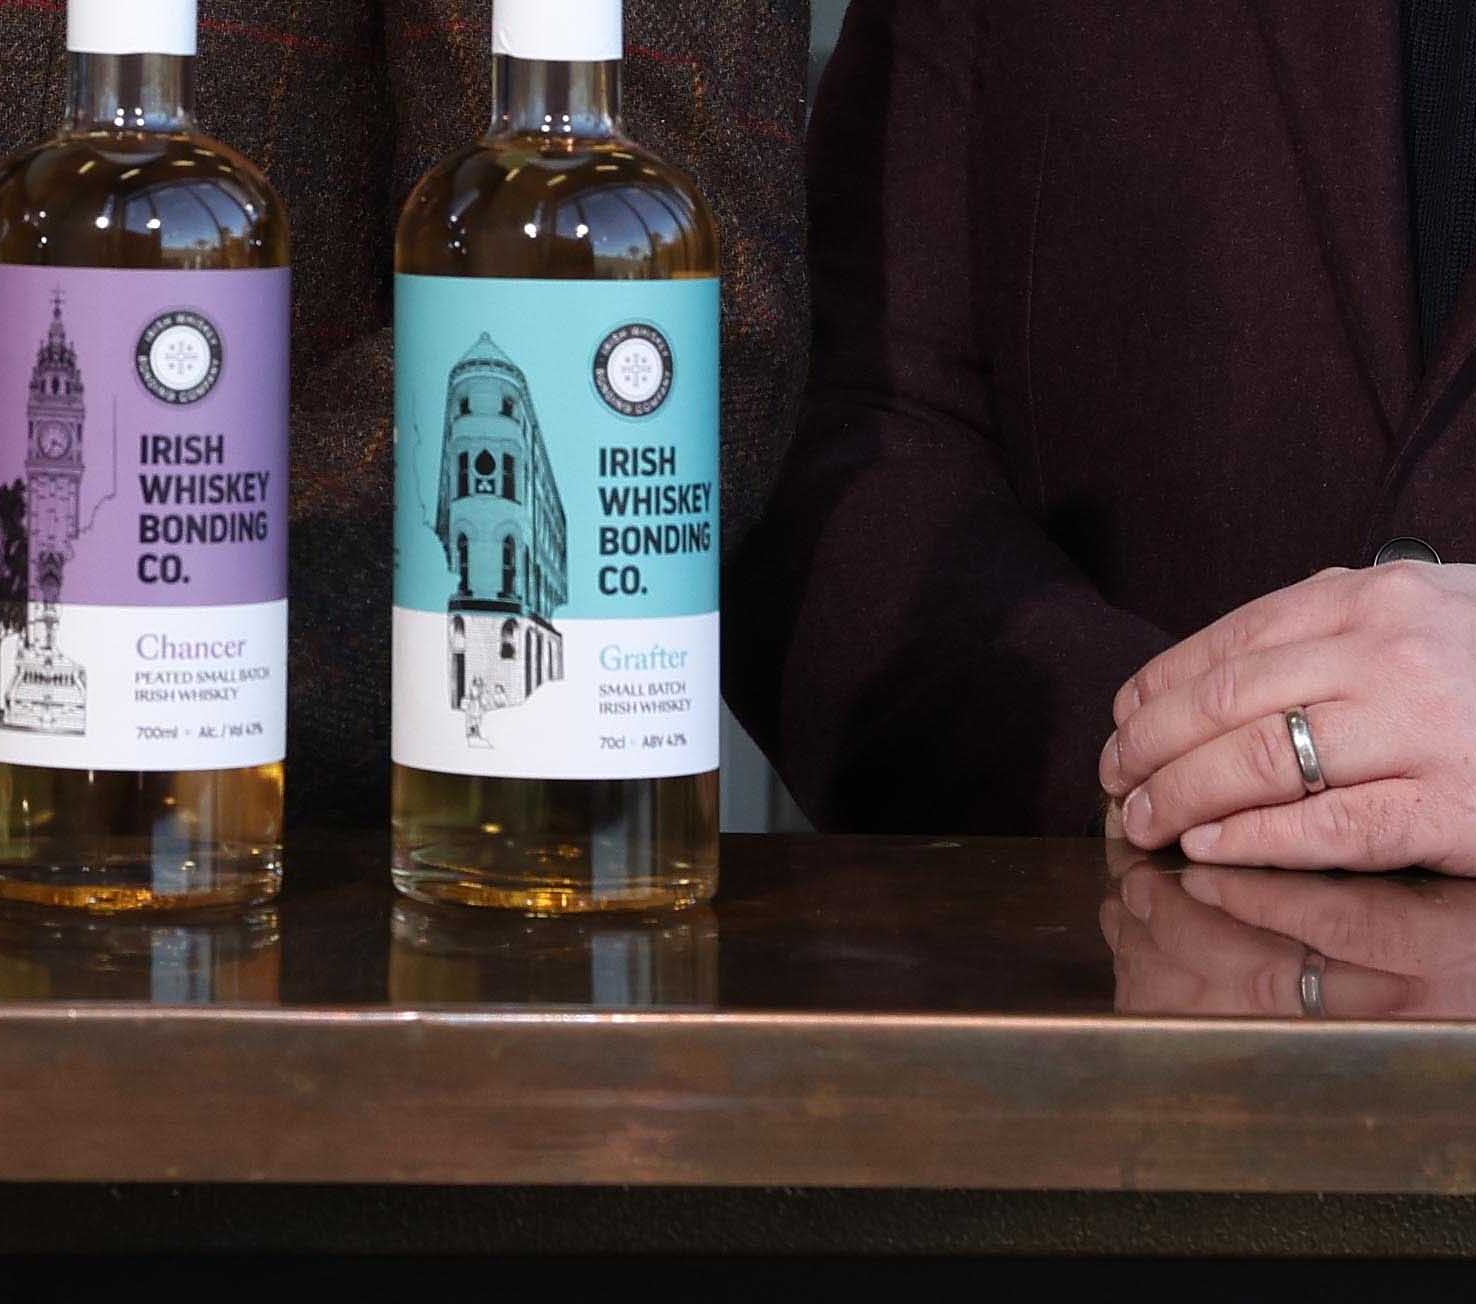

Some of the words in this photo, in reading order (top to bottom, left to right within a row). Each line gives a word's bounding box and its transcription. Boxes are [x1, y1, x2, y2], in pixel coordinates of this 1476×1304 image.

[139, 434, 224, 465] IRISH
[599, 446, 676, 477] IRISH
[138, 470, 269, 505] WHISKEY
[599, 481, 712, 516] WHISKEY
[139, 510, 269, 543] BONDING
[599, 521, 711, 556] BONDING
[137, 553, 190, 584] CO.
[598, 564, 648, 596] CO.
[135, 632, 247, 660] Chancer
[599, 643, 688, 672] Grafter
[134, 671, 194, 684] PEATED
[196, 669, 237, 683] SMALL
[598, 682, 645, 697] SMALL
[647, 681, 686, 696] BATCH
[134, 689, 176, 702] IRISH
[177, 687, 239, 702] WHISKEY
[598, 701, 638, 715] IRISH
[639, 698, 692, 715] WHISKEY
[136, 725, 178, 739] 700ml
[599, 735, 626, 750] 70cl
